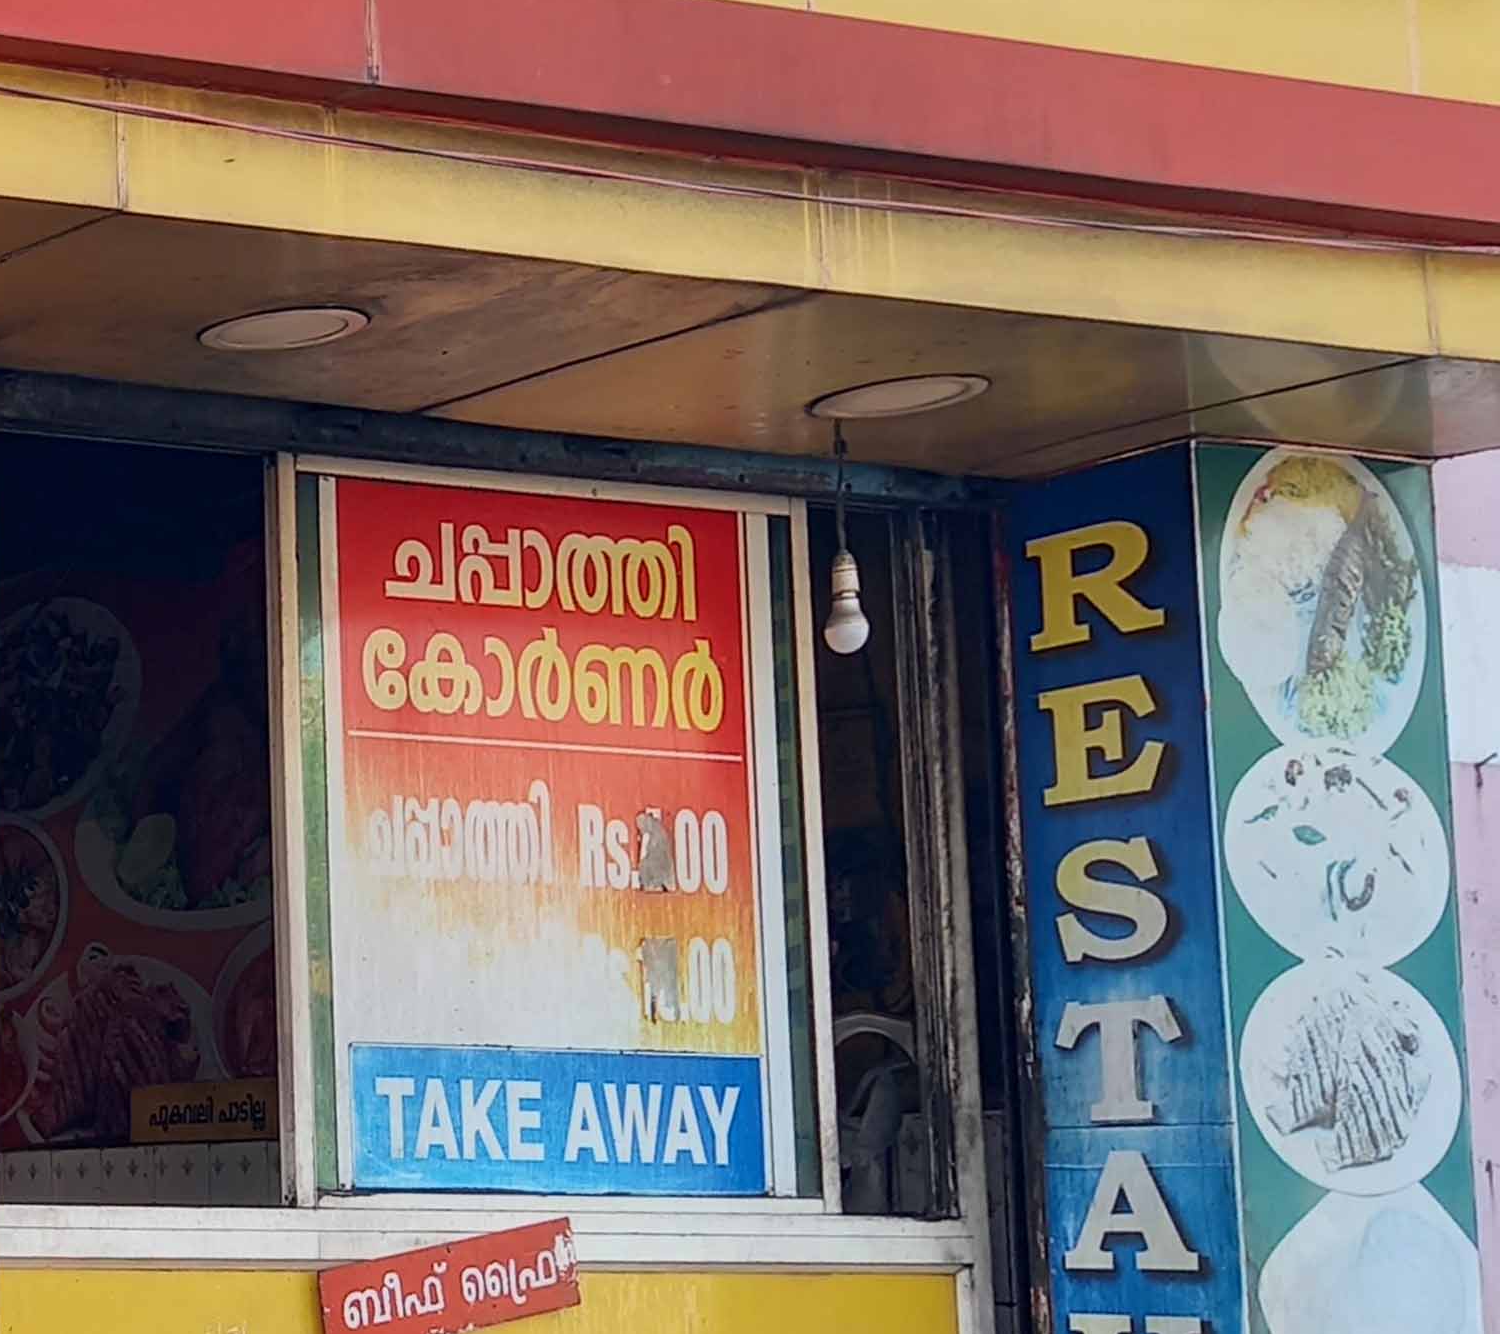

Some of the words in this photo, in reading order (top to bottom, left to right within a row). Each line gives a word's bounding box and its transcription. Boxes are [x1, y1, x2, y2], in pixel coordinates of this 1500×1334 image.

[384, 521, 697, 621] ചപ്പാത്തി
[361, 627, 725, 733] കോർണർ
[375, 1075, 543, 1163] TAKE
[564, 1080, 742, 1166] AWAY
[341, 1260, 448, 1330] ബീഫ്
